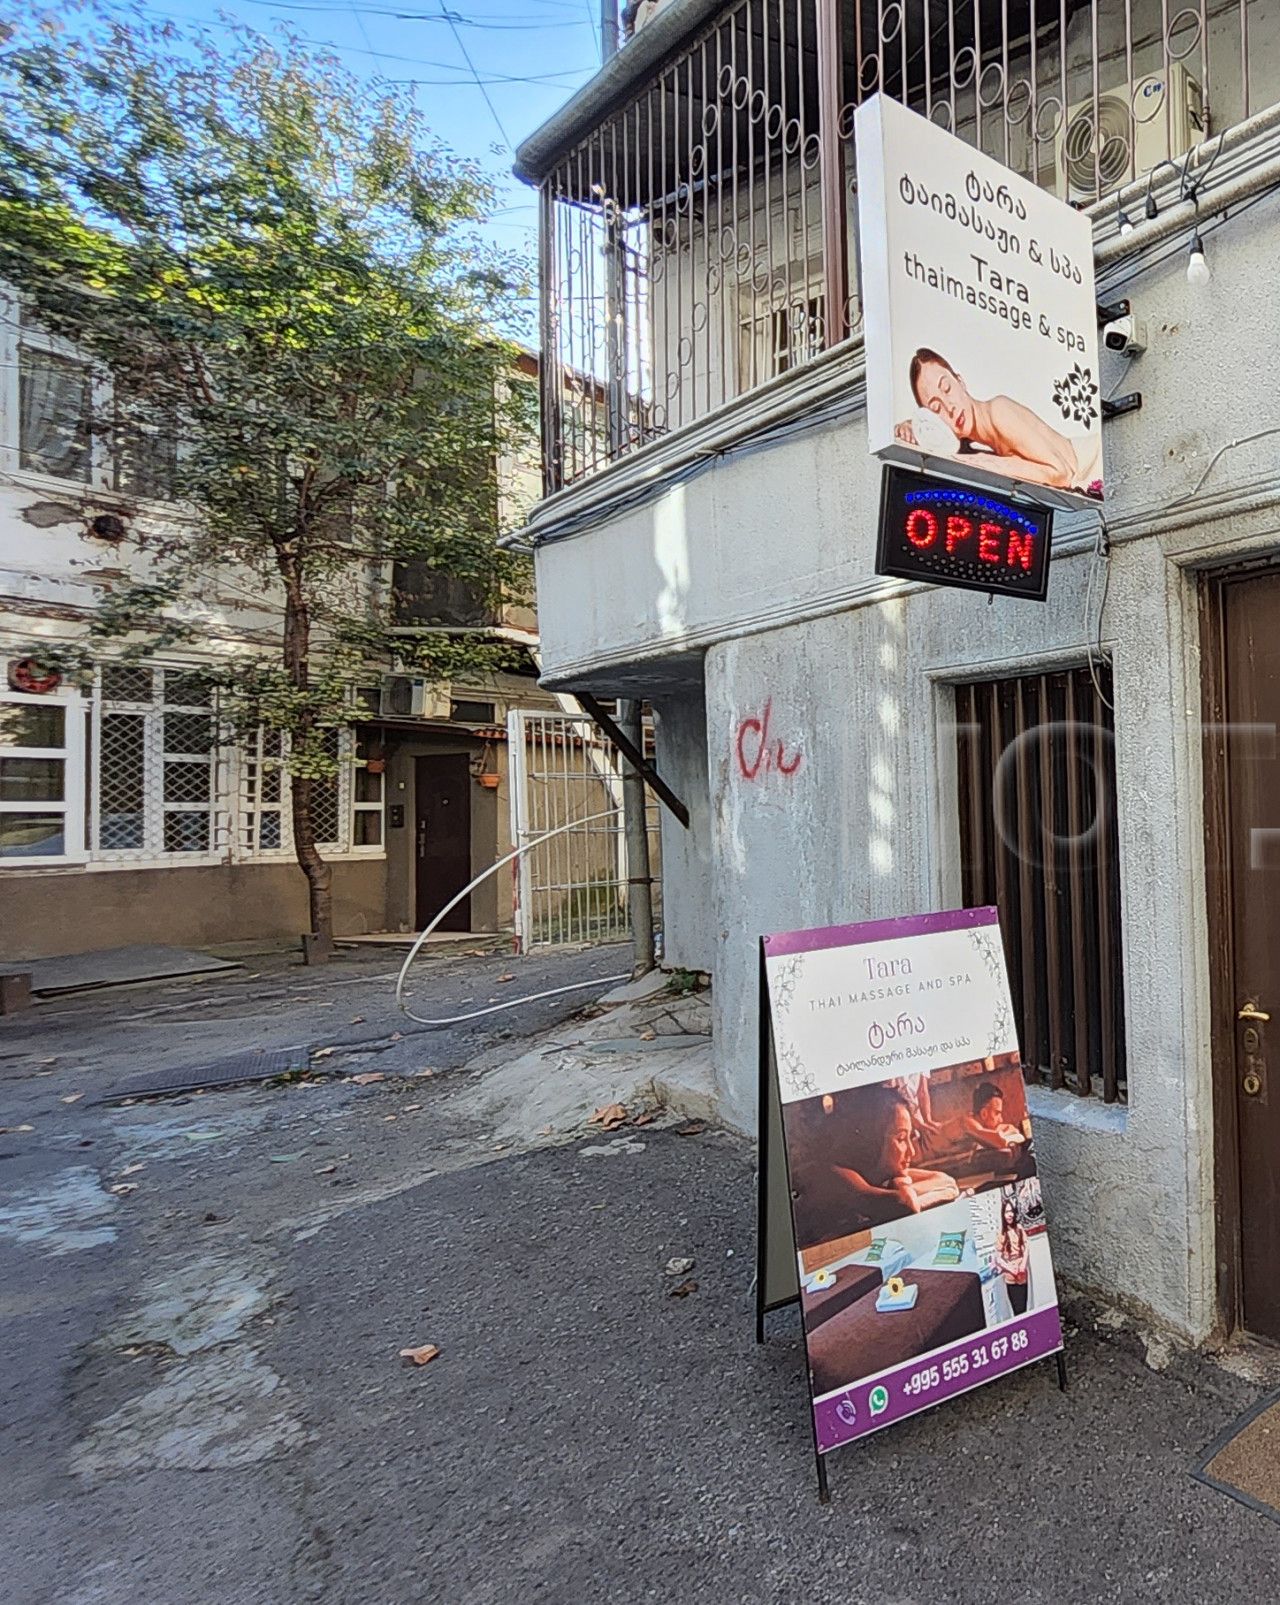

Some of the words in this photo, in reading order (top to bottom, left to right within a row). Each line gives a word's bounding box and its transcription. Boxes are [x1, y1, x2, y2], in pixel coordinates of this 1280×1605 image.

[966, 170, 1027, 220] ტარა
[899, 173, 1020, 254] ტაიმასაჟი
[1028, 239, 1044, 267] &
[1050, 247, 1082, 285] სპა
[904, 251, 1032, 330] thaimassage
[1038, 314, 1052, 339] &
[1056, 326, 1086, 353] spa
[970, 254, 1030, 304] Tara
[905, 509, 1034, 570] OPEN
[808, 996, 842, 1012] THAI
[848, 984, 911, 1004] MASSAGE
[918, 978, 944, 992] AND
[948, 973, 972, 987] SPA
[863, 954, 913, 981] Tara
[868, 1011, 926, 1049] ტარა
[903, 1366, 940, 1396] +995
[943, 1354, 969, 1382] 555
[972, 1345, 989, 1370] 31
[991, 1336, 1009, 1360] 67
[1011, 1328, 1029, 1352] 88
